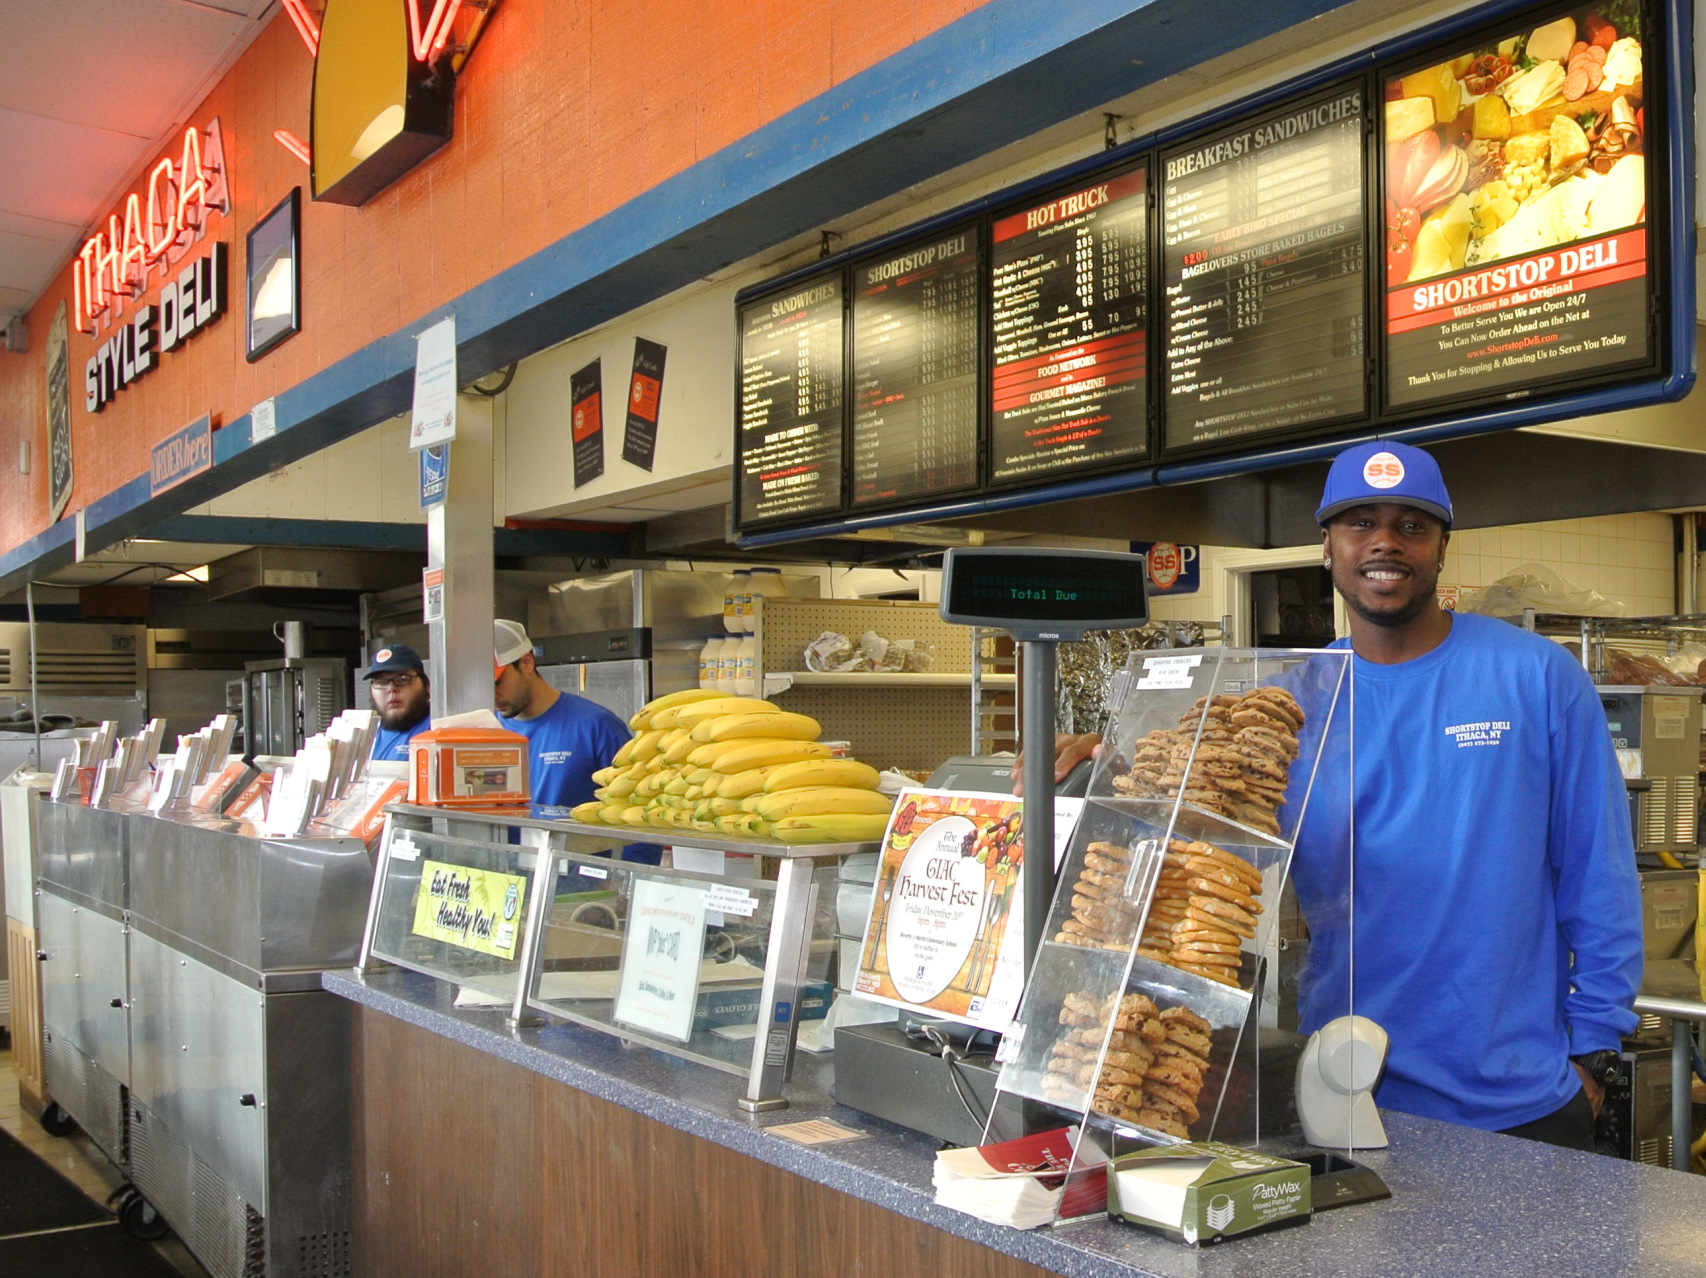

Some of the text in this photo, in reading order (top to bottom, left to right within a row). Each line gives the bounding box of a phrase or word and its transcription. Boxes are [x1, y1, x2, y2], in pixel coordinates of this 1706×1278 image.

[1167, 133, 1252, 181] BREAKFAST
[1254, 92, 1361, 149] SANDWICHES
[1027, 184, 1109, 230] HOT TRUCK
[74, 120, 222, 335] ITHACA
[867, 247, 936, 284] SHORTSTOP
[938, 236, 965, 260] DELI
[1182, 253, 1239, 280] BAGELOVERS
[1240, 244, 1270, 262] STORE
[1272, 233, 1305, 252] BAKED
[1307, 221, 1345, 242] BAGELS
[1167, 282, 1182, 295] Bagel
[1413, 240, 1618, 311] SHORTSTOP DELI
[771, 282, 835, 318] SANDWICHES
[1440, 293, 1587, 335] To Better Serve You We are Open 24/7
[1453, 280, 1573, 318] Welcome to the Original
[86, 241, 227, 413] STYLE DELI
[1438, 309, 1590, 351] You Can Now Order Ahead on the Net at
[1408, 334, 1627, 386] Thank You for Stopping & Allowing Us to Serve You Today
[1467, 333, 1558, 359] www.ShortstopDeli.com
[1038, 354, 1096, 378] FOOD NETWORK
[1029, 376, 1106, 403] GOURMET MAGAZINE!
[152, 433, 208, 486] ORDER here
[1367, 462, 1401, 477] SS
[1153, 554, 1176, 571] SS
[1010, 588, 1077, 600] Total Due
[1444, 721, 1511, 736] SHORTSTOP DELI
[1455, 730, 1502, 742] ITHACA, NY
[935, 841, 960, 853] Annual
[431, 869, 471, 901] Eat Fresh
[926, 857, 960, 882] GIAC
[899, 875, 978, 907] Harvest Fest
[436, 900, 497, 940] Healthy You!
[1253, 1181, 1301, 1201] PattyWax
